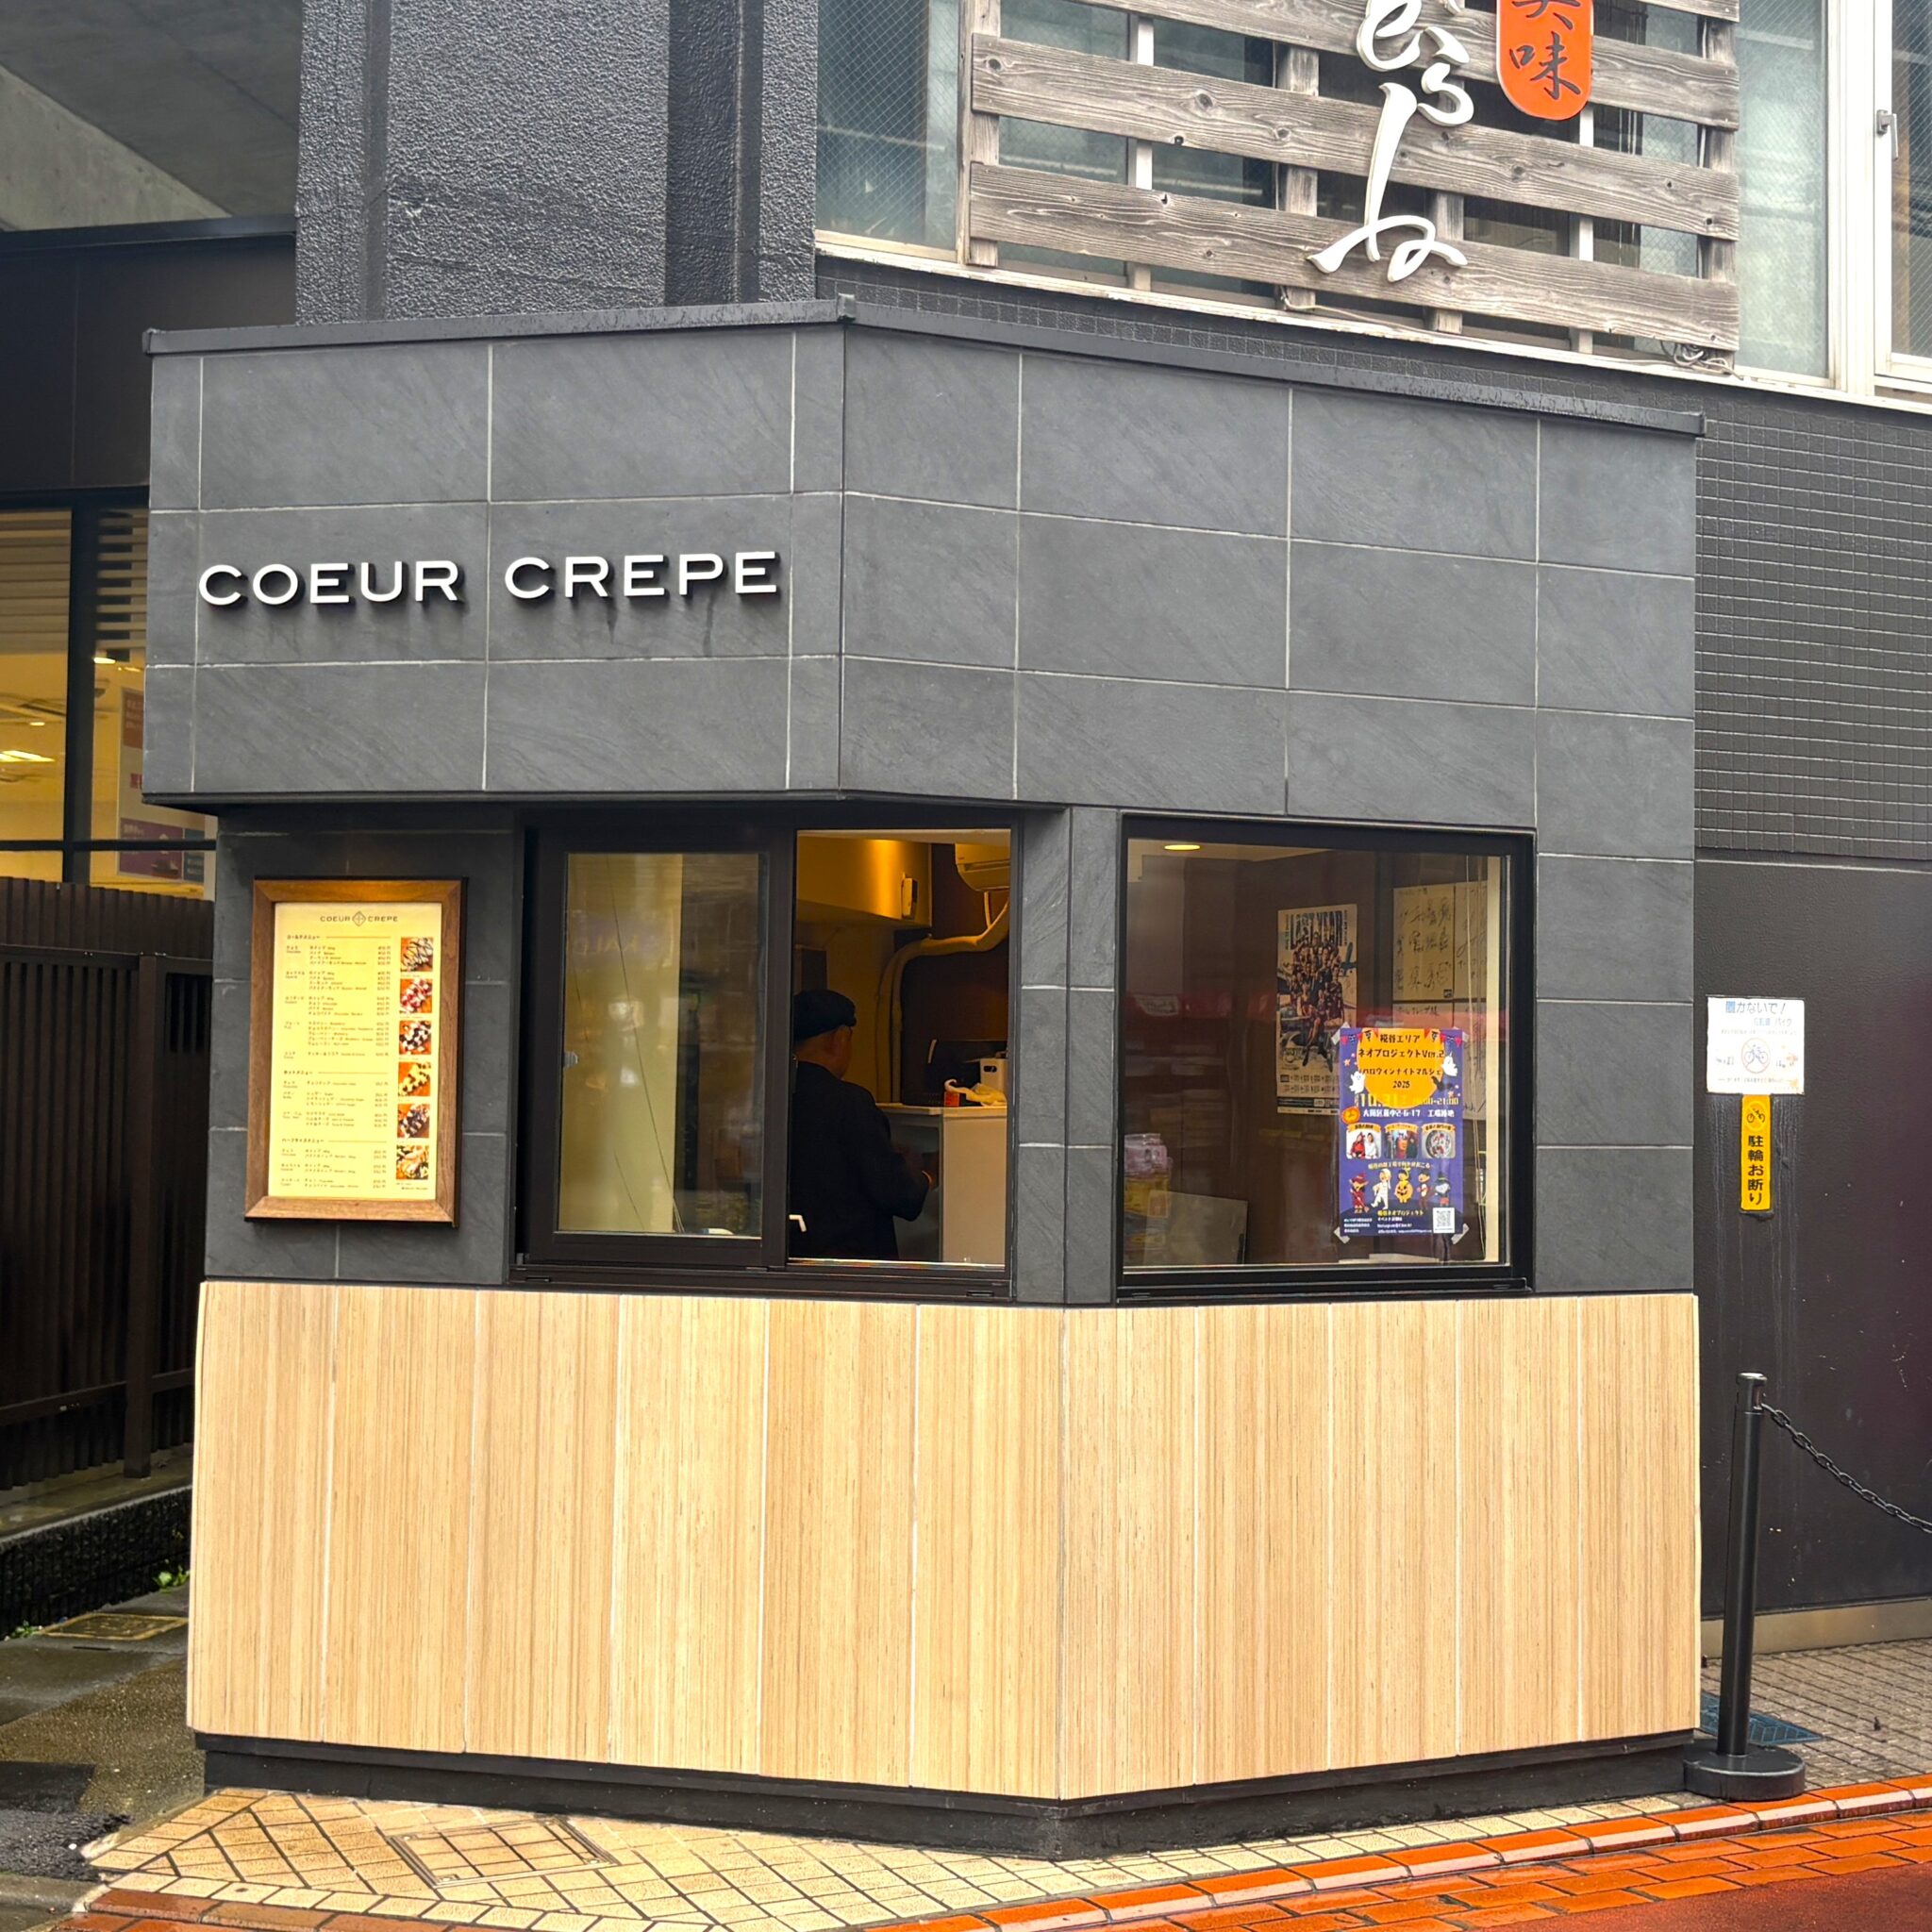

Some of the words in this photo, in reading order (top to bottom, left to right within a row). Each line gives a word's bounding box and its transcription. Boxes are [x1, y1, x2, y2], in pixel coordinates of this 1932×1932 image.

[199, 560, 459, 606] COEUR
[505, 551, 777, 599] CREPE
[1391, 1080, 1410, 1089] 2025
[1747, 1135, 1764, 1206] 駐輪お断り
